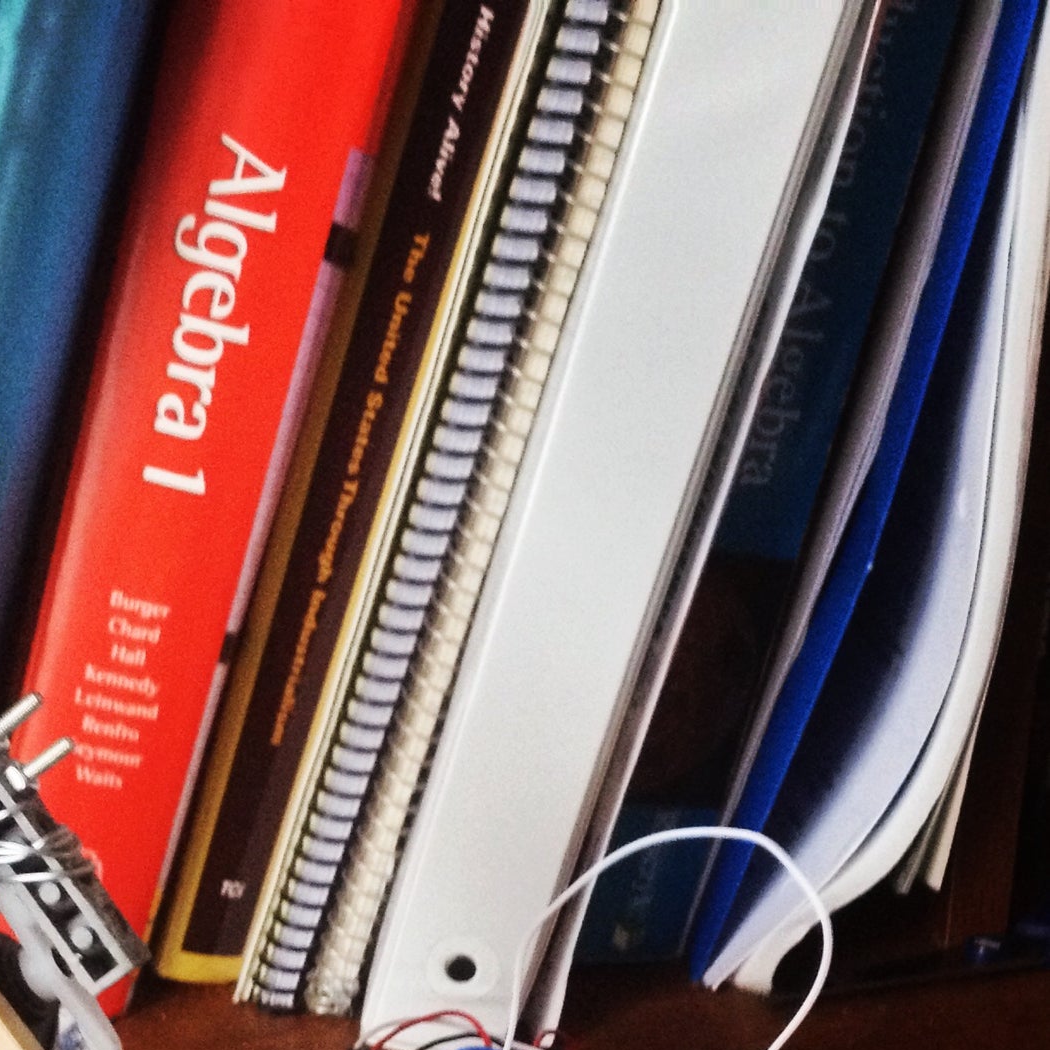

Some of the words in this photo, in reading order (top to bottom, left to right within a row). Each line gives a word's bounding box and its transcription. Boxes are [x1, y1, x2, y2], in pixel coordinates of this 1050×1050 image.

[451, 4, 495, 112] History
[428, 116, 460, 202] Alive!
[154, 133, 287, 440] Algebra
[403, 233, 430, 283] The
[374, 291, 412, 384] United
[348, 392, 383, 475] States
[143, 464, 206, 496] 1
[317, 478, 359, 583] Through
[85, 663, 159, 698] Kennedy
[111, 644, 146, 667] Hall
